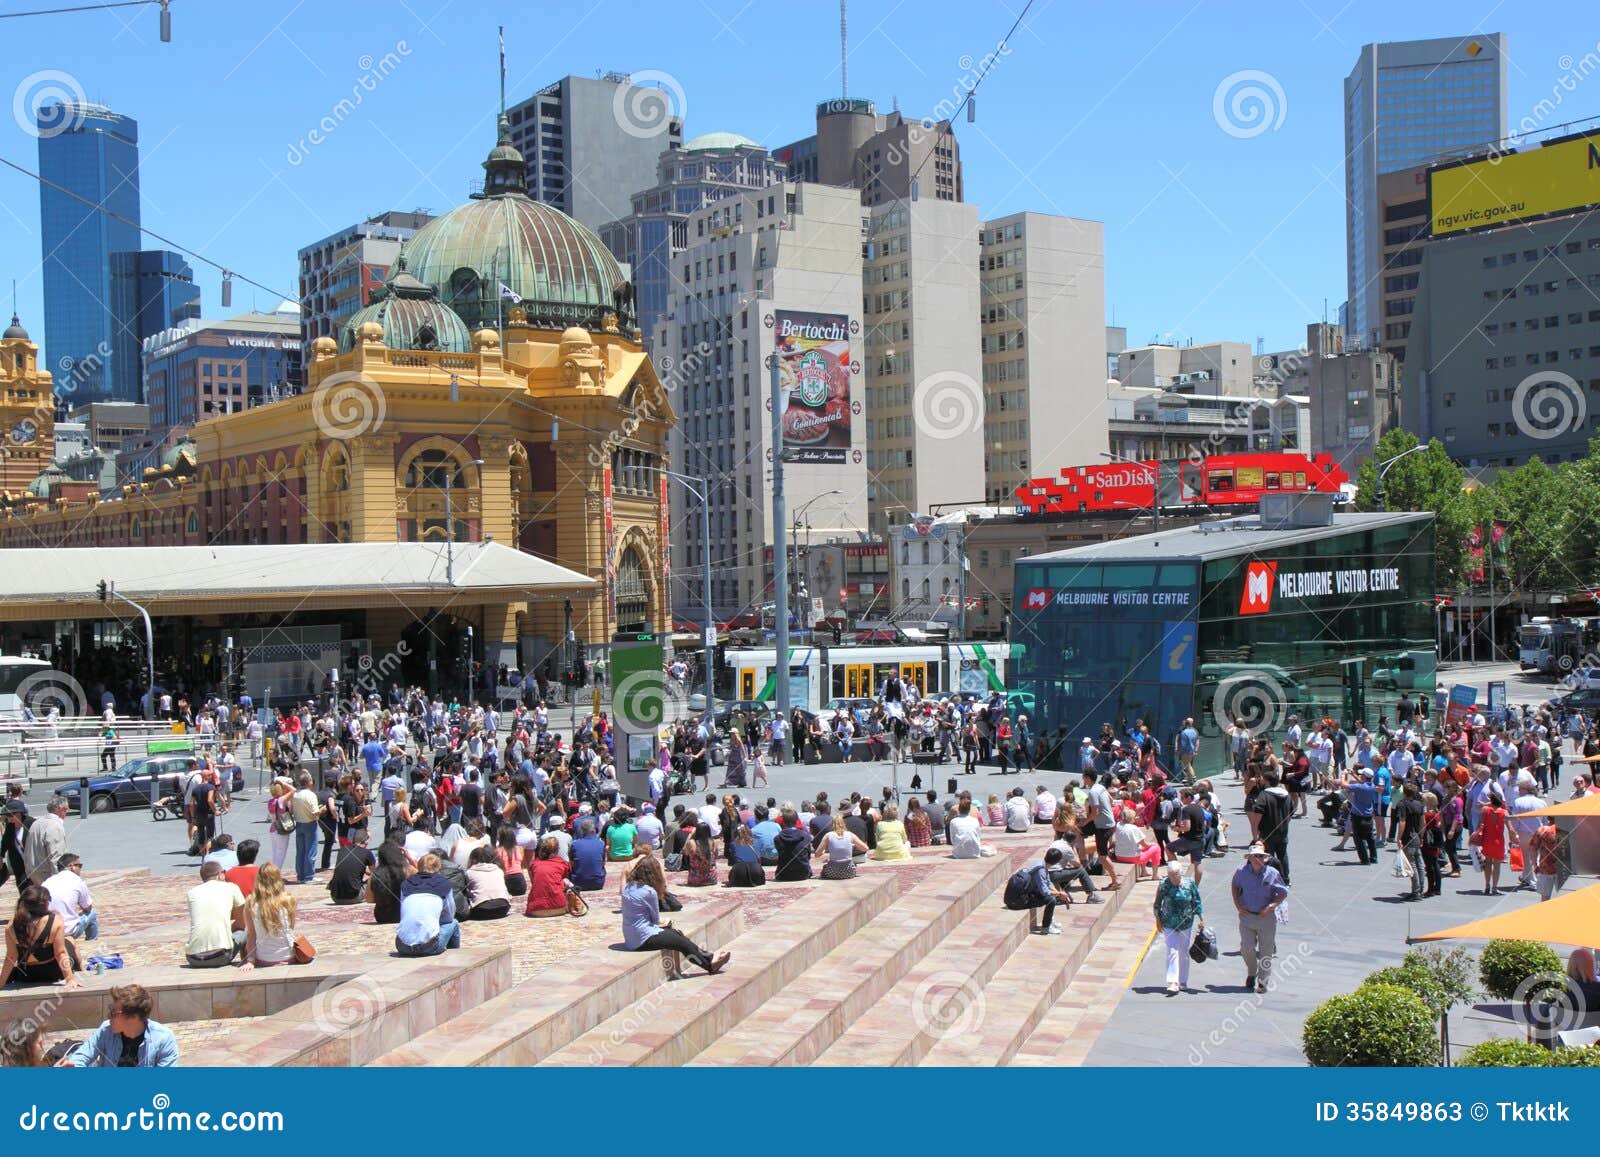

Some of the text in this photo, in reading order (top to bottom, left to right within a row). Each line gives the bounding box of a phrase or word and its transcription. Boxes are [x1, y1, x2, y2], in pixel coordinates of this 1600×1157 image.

[1438, 202, 1525, 227] ngv.vic.gov.au
[781, 319, 845, 340] Bertocchi
[227, 335, 275, 348] VICTORIA
[1096, 468, 1154, 488] SanDisk
[1016, 505, 1031, 513] APN
[1279, 568, 1399, 598] MELBOURNE VISITOR CENTRE
[1056, 593, 1190, 605] MELBOURNE VISITOR CENTRE
